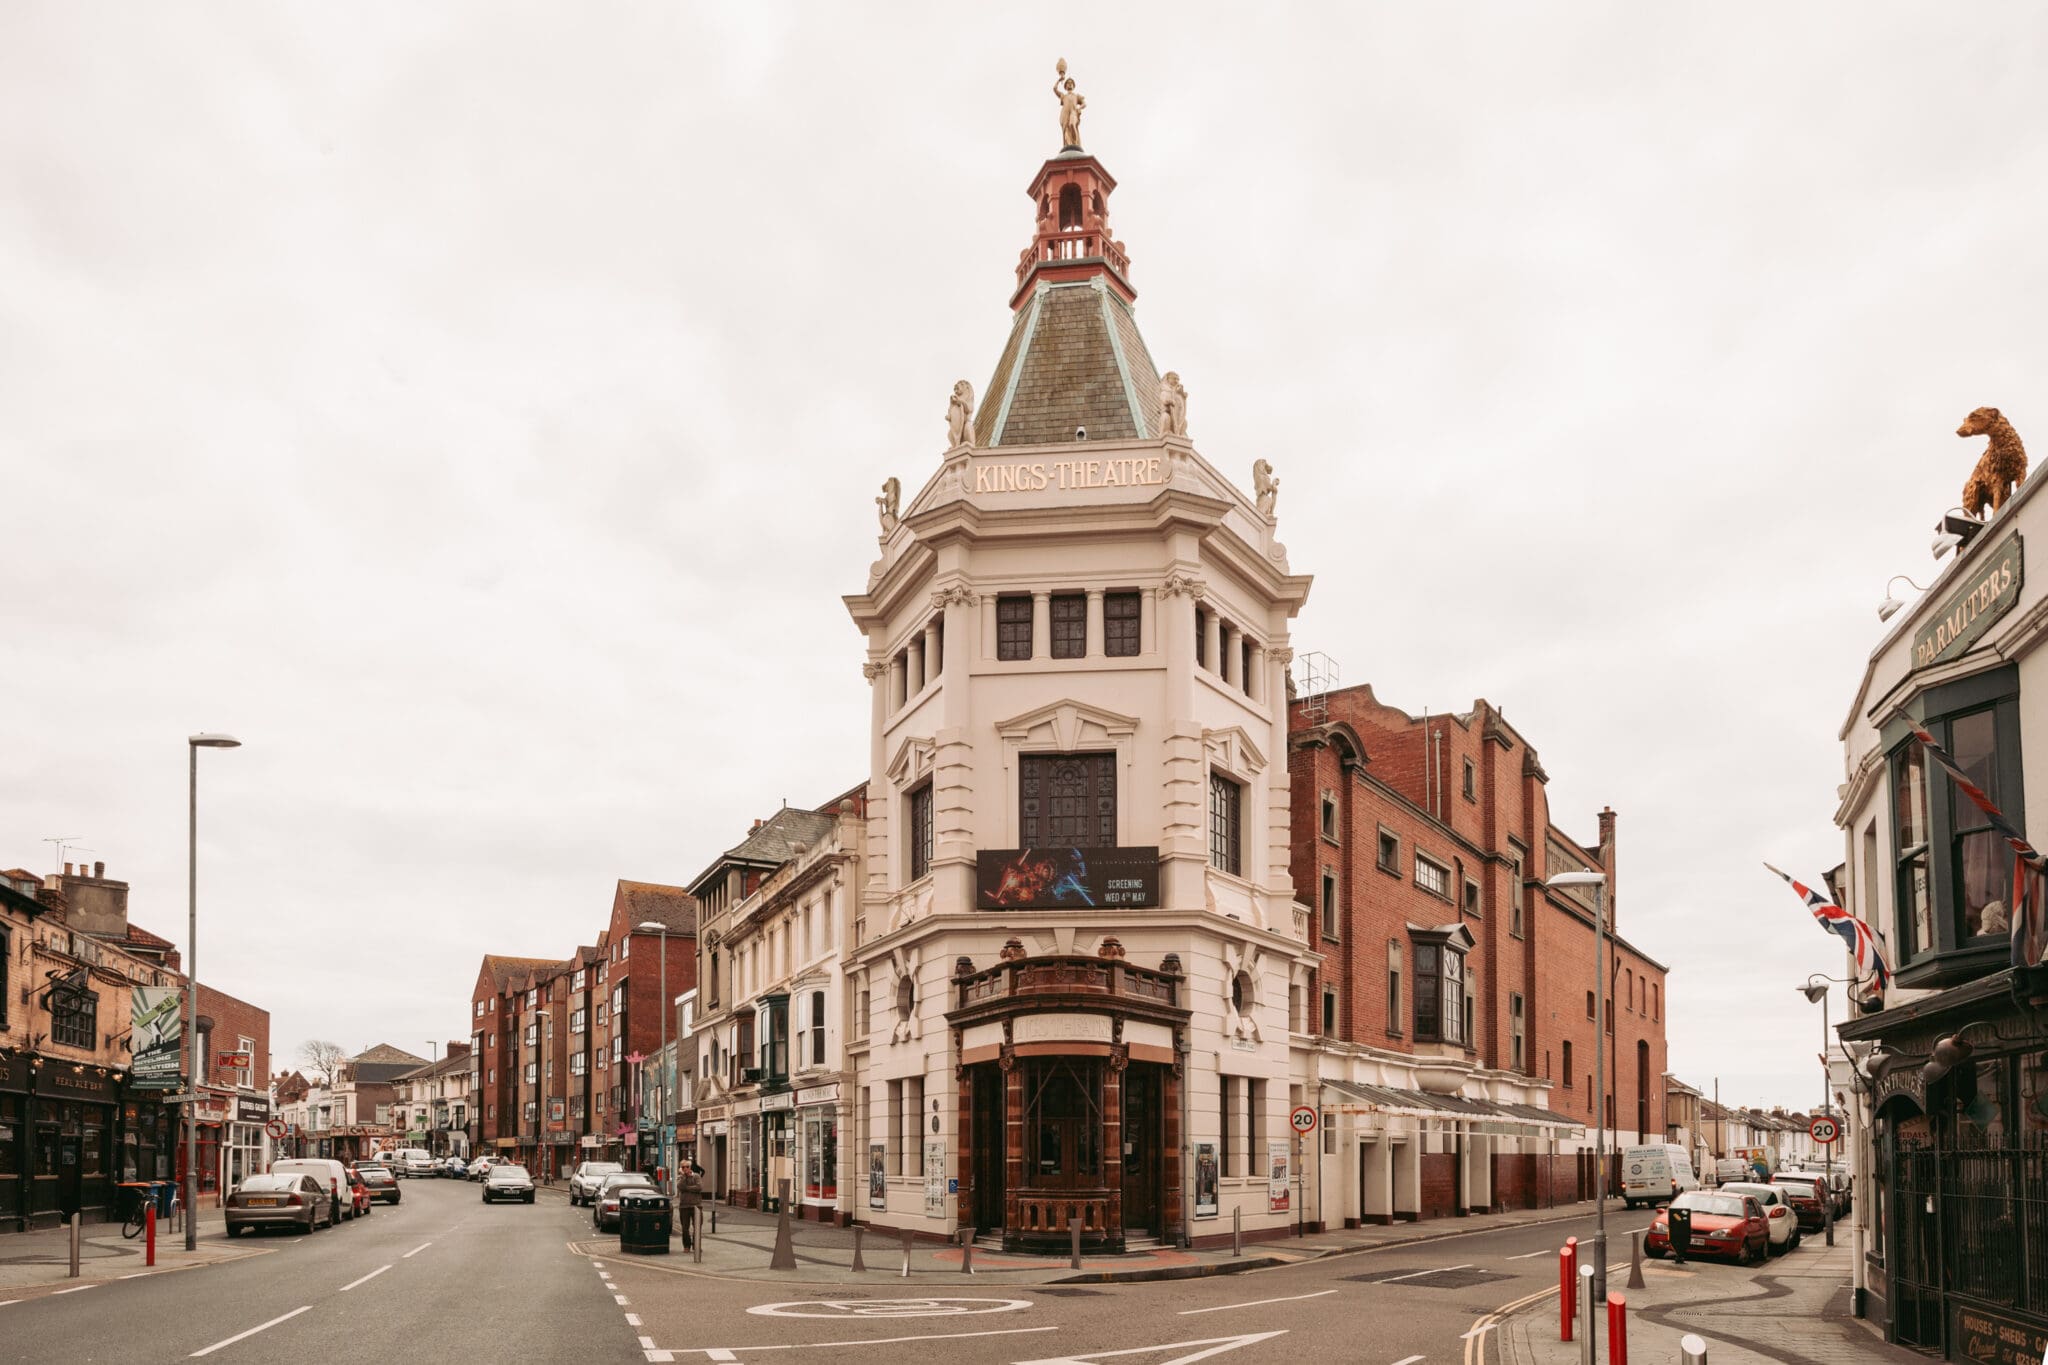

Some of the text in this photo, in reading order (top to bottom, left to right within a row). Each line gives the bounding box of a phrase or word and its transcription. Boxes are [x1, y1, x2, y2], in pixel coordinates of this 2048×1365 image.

[1054, 457, 1163, 489] THEATRE
[1917, 558, 2011, 667] PARMITERS
[1107, 879, 1143, 889] SCREENING
[1104, 892, 1120, 902] WED
[1132, 892, 1146, 902] MAY
[1294, 1114, 1312, 1125] 20
[1813, 1125, 1834, 1136] 20
[1964, 1315, 1993, 1336] HOUSES
[1999, 1326, 2027, 1348] SHEDS
